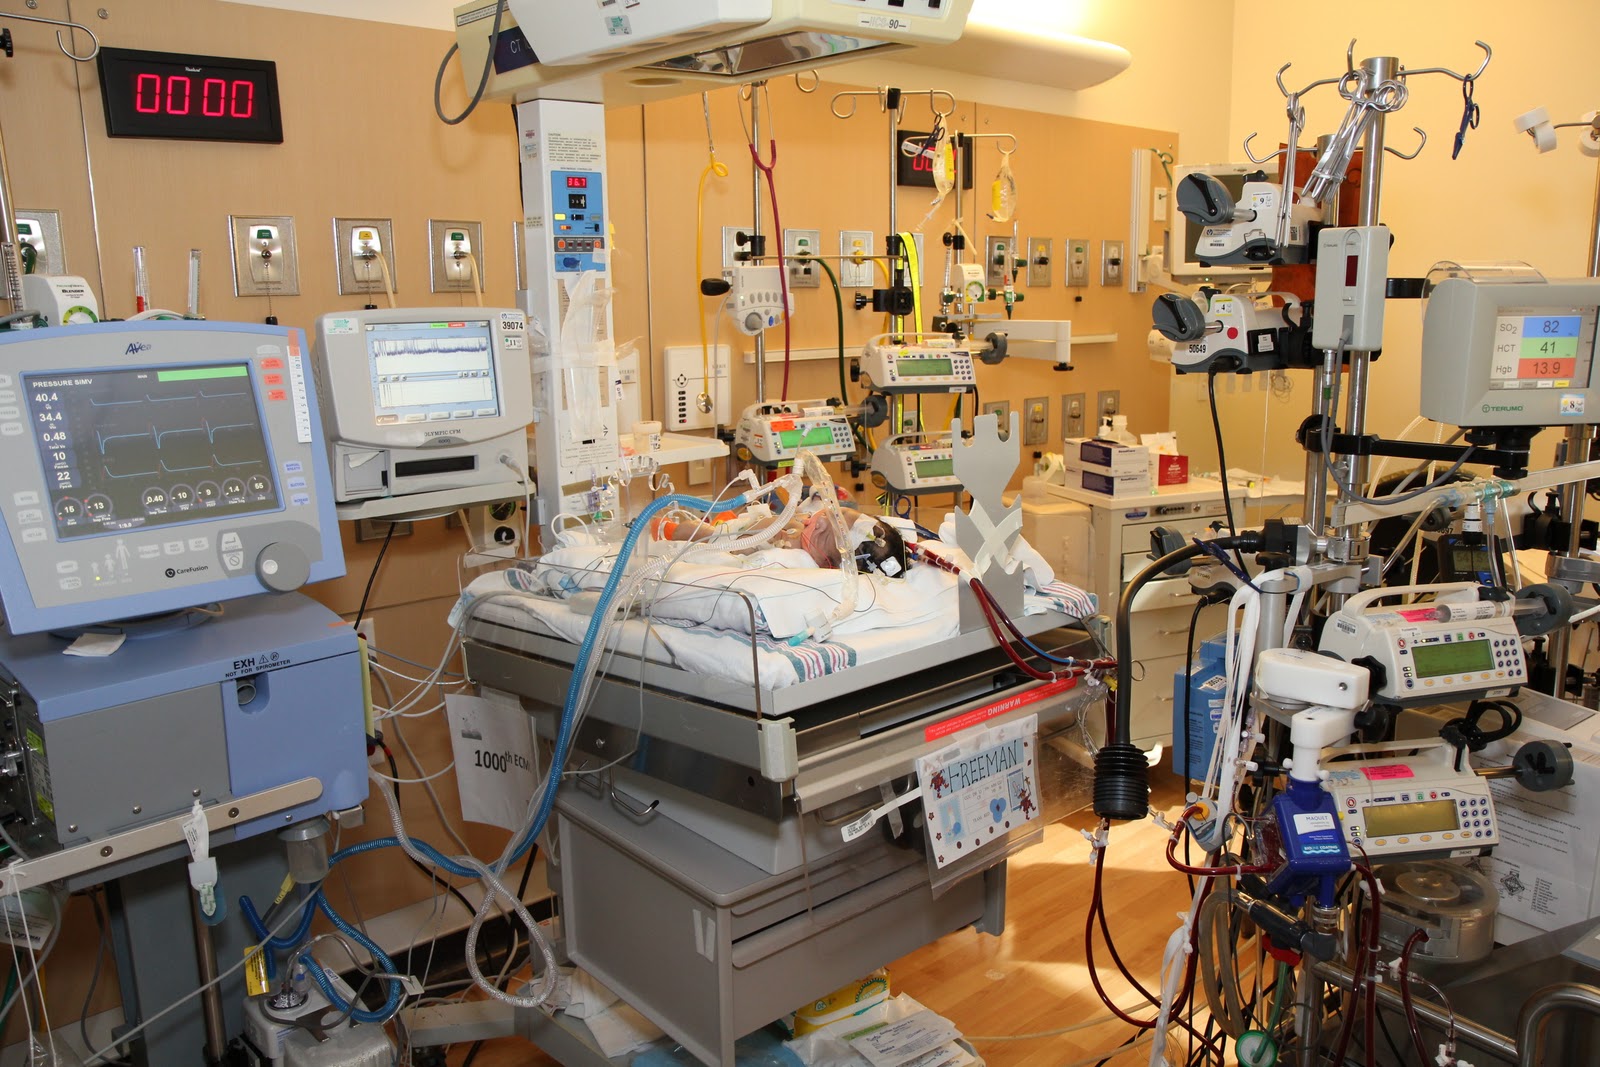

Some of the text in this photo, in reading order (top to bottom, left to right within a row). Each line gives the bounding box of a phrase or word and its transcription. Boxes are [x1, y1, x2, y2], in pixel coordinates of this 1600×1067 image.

[502, 321, 524, 330] 39074
[1542, 320, 1560, 334] 82
[1189, 344, 1206, 353] 50649
[1497, 341, 1556, 354] HCT 41
[1496, 362, 1561, 375] Hgb 13.9
[32, 380, 74, 388] PRESSURE
[35, 392, 58, 402] 40.4
[1569, 400, 1575, 409] 8
[39, 412, 62, 422] 34.4
[43, 432, 66, 442] 0.48
[53, 452, 66, 461] 10
[57, 472, 71, 481] 22
[93, 502, 104, 510] 13
[147, 494, 164, 503] 0.40
[178, 491, 187, 500] 10
[205, 488, 212, 496] 9
[176, 565, 208, 576] CareFusion
[233, 657, 255, 670] EXH
[255, 659, 291, 672] SPIROMETER
[988, 697, 1021, 716] WARNING
[474, 749, 513, 773] 1000th
[948, 739, 1018, 793] FREEMAN
